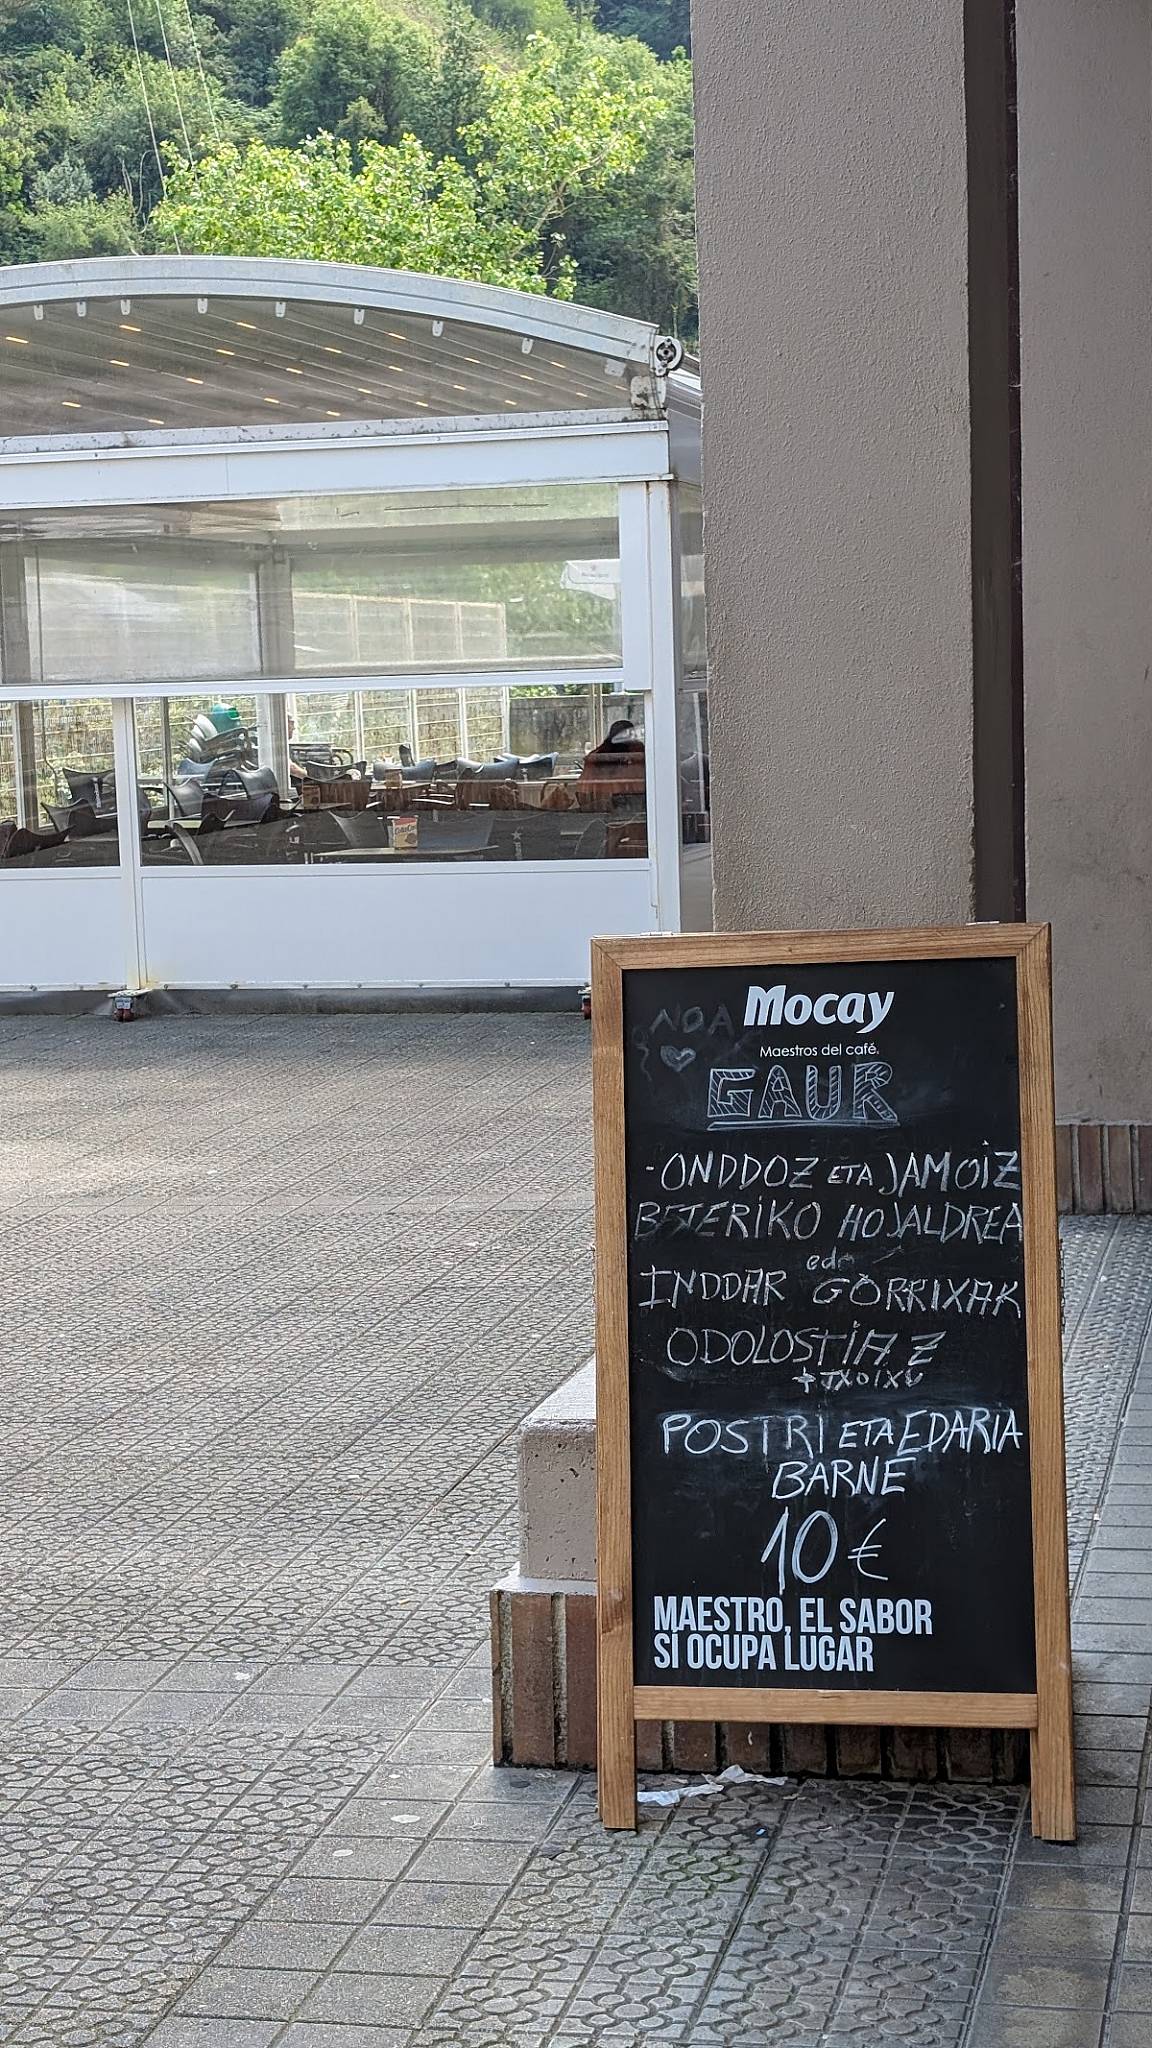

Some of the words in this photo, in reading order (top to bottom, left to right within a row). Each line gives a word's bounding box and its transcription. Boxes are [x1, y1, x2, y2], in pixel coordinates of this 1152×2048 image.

[744, 985, 895, 1033] Mocay
[760, 1045, 817, 1058] Maestros
[822, 1043, 842, 1056] del
[707, 1062, 898, 1122] GAUR
[827, 1163, 873, 1186] ETA
[838, 1201, 1024, 1245] HOJALDREA
[662, 1413, 824, 1459] POSTRI
[839, 1418, 894, 1448] ETA
[897, 1407, 1024, 1457] EDARIA
[772, 1455, 917, 1500] BARNE
[654, 1596, 792, 1637] MAESTRO,
[800, 1598, 832, 1633] EL
[839, 1599, 933, 1635] SABOR
[687, 1634, 777, 1671] OCUPA
[784, 1635, 875, 1673] LUGAR
